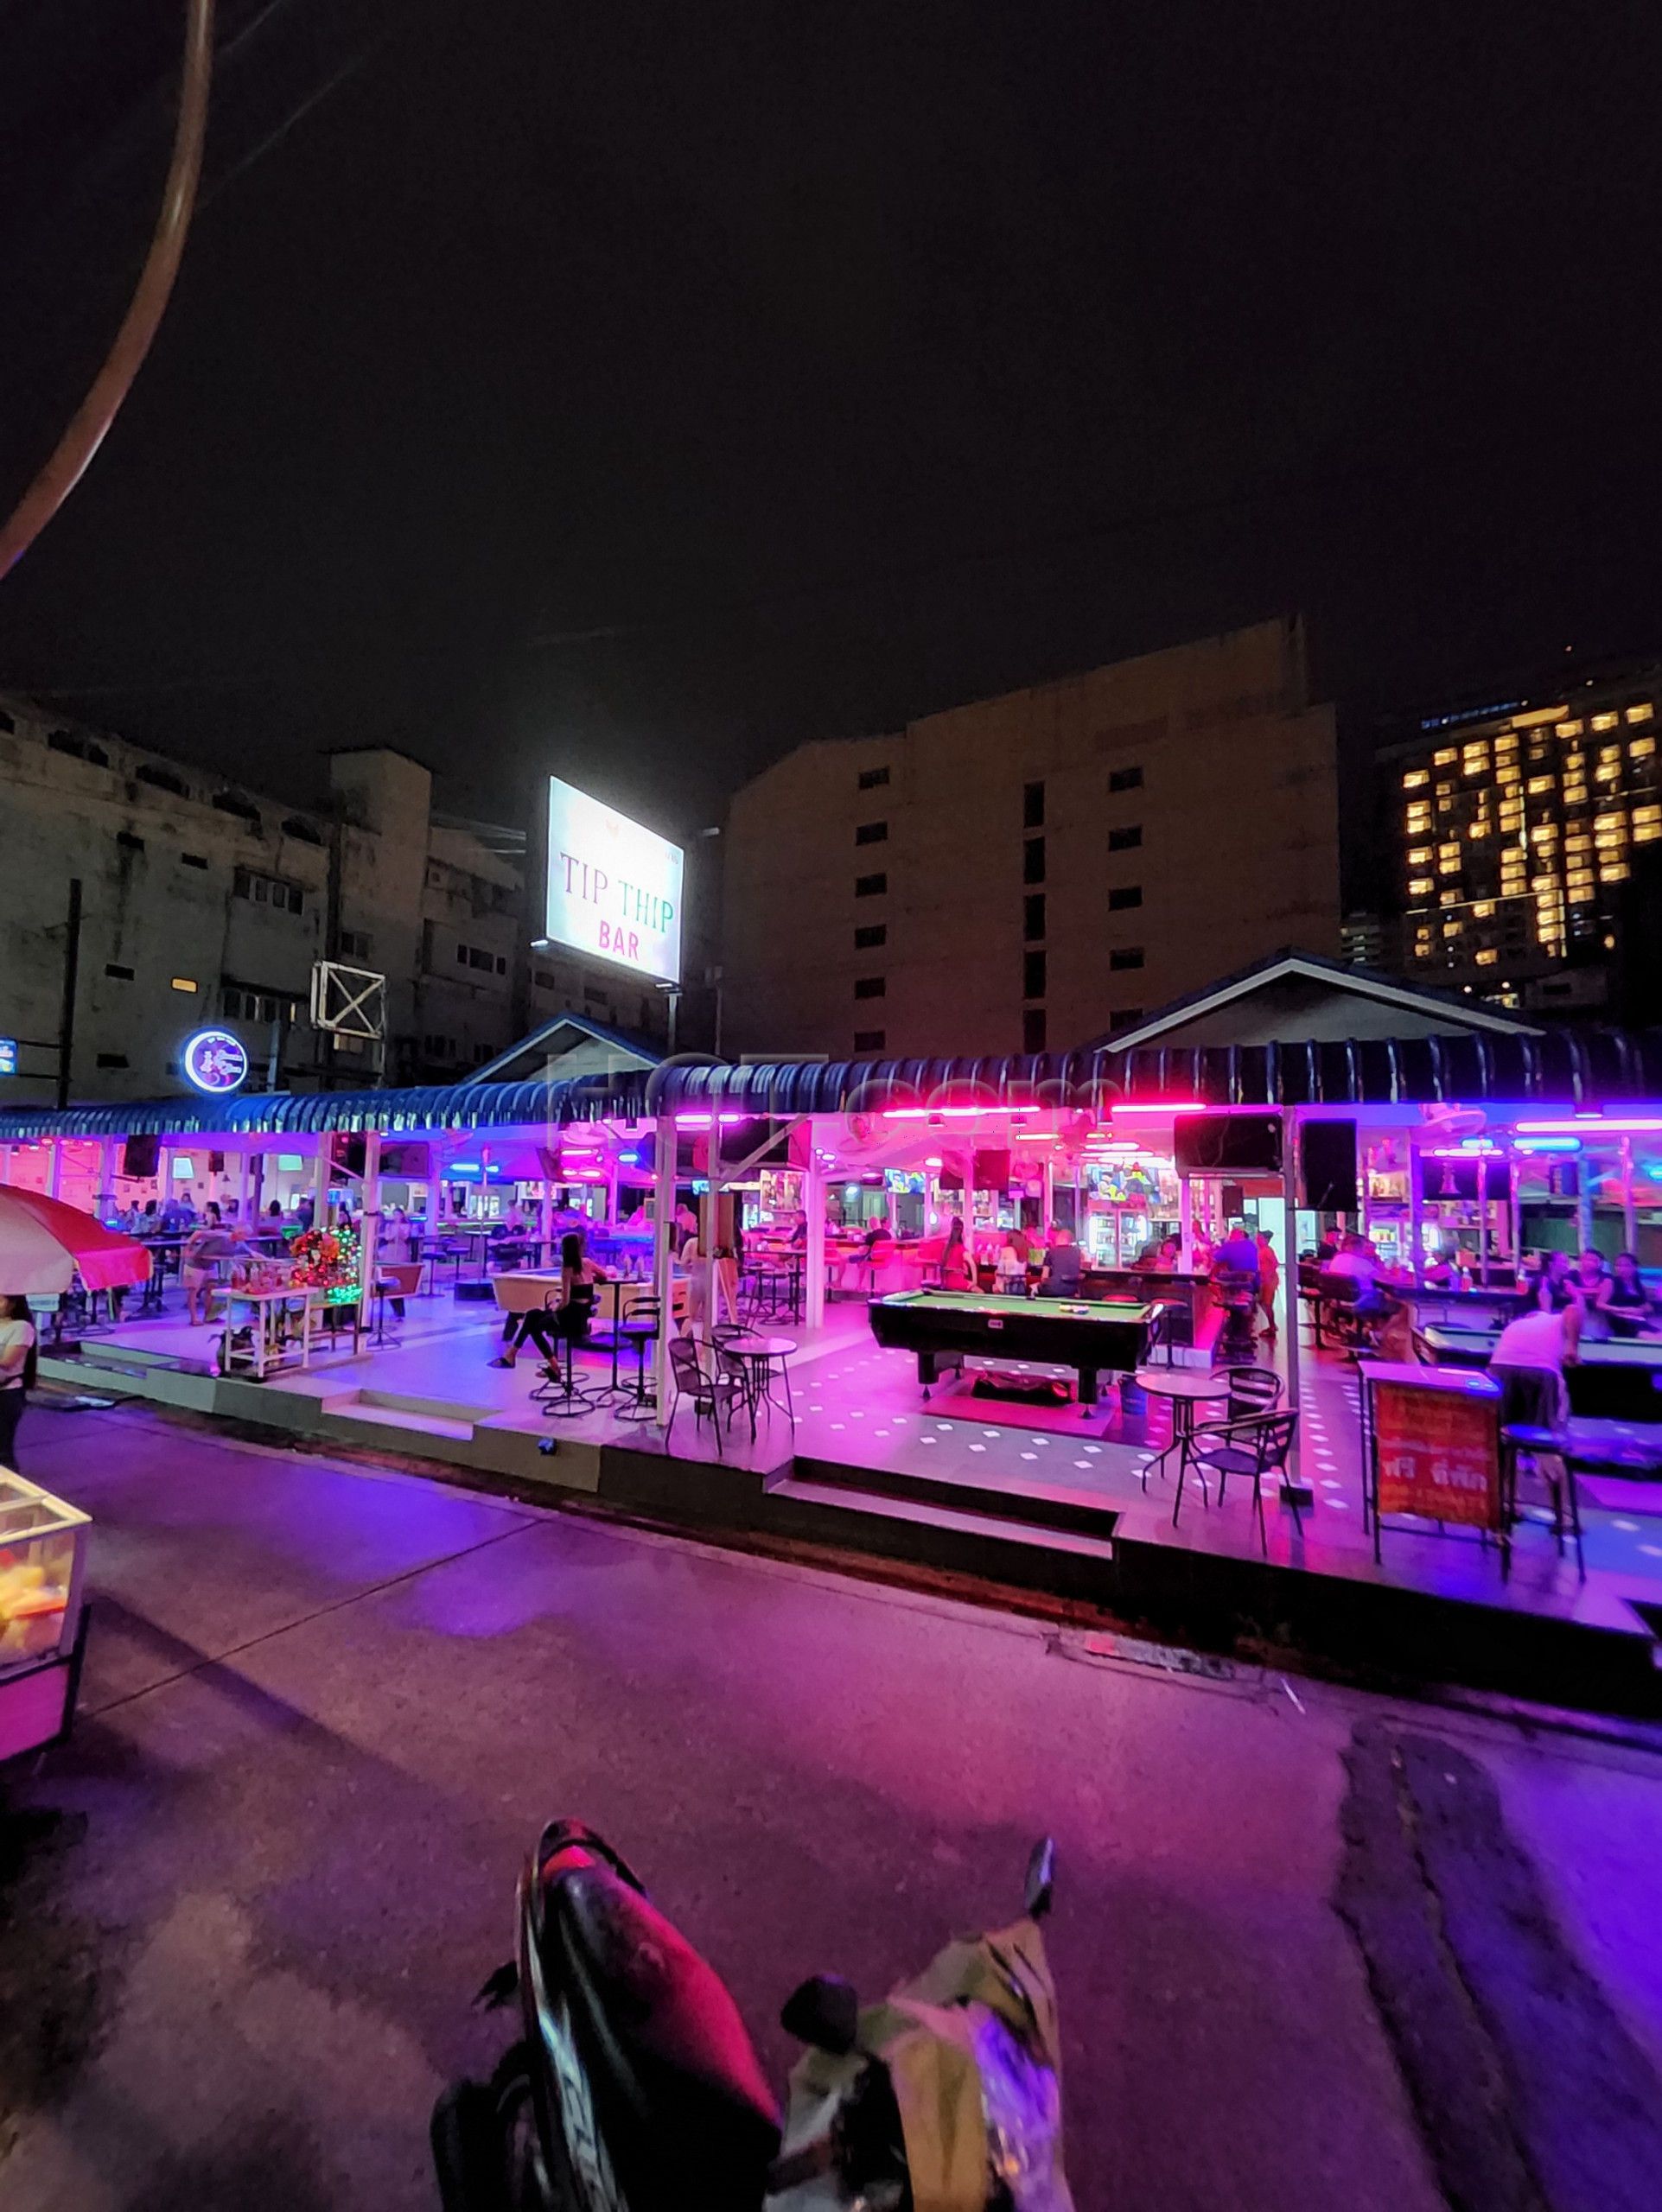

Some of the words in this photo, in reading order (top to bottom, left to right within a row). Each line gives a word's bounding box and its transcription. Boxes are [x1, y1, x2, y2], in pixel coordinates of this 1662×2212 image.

[561, 853, 608, 904] TIP
[619, 880, 673, 933] THIP
[600, 920, 639, 961] BAR
